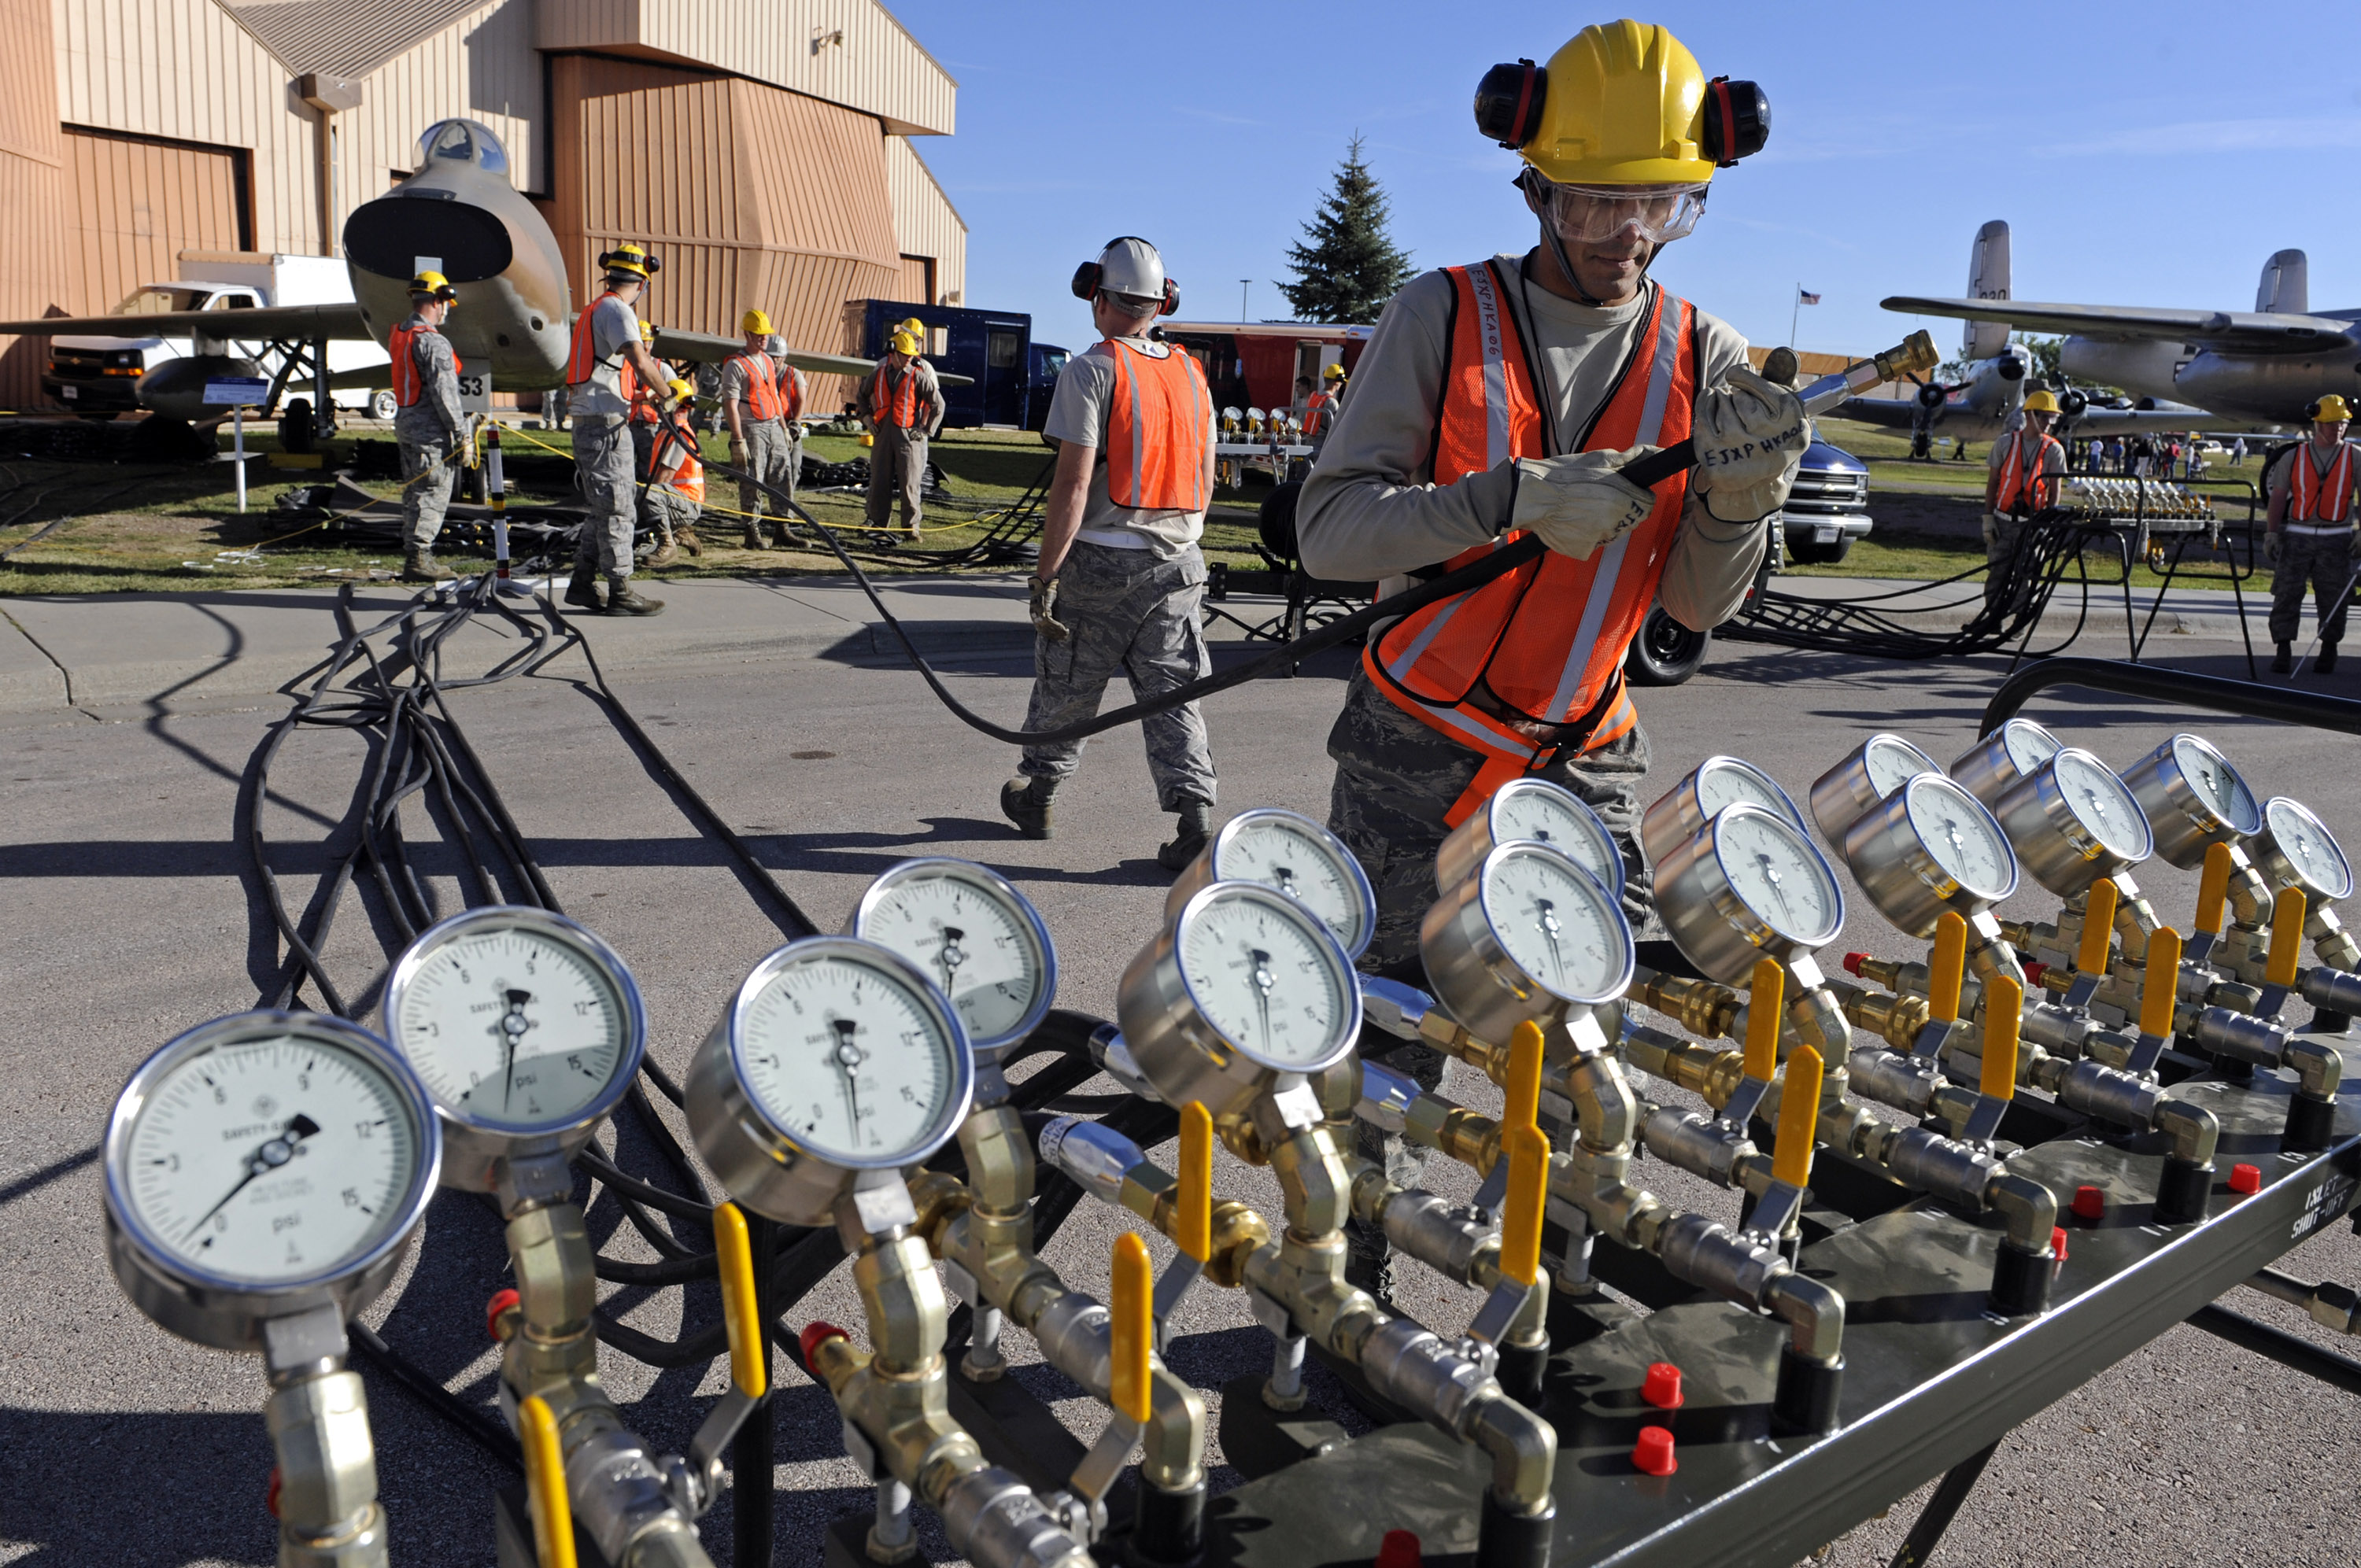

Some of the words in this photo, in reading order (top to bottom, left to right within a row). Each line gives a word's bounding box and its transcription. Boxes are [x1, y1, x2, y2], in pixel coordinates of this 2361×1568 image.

[459, 377, 482, 396] 53
[1705, 443, 1754, 467] EJXP
[573, 1000, 589, 1016] 12
[900, 1031, 914, 1046] 12
[567, 1055, 583, 1071] 15
[515, 1072, 538, 1089] psi
[356, 1123, 371, 1138] 12
[171, 1155, 179, 1171] 3
[342, 1189, 359, 1205] 15
[216, 1216, 225, 1231] 0
[272, 1215, 301, 1233] psi
